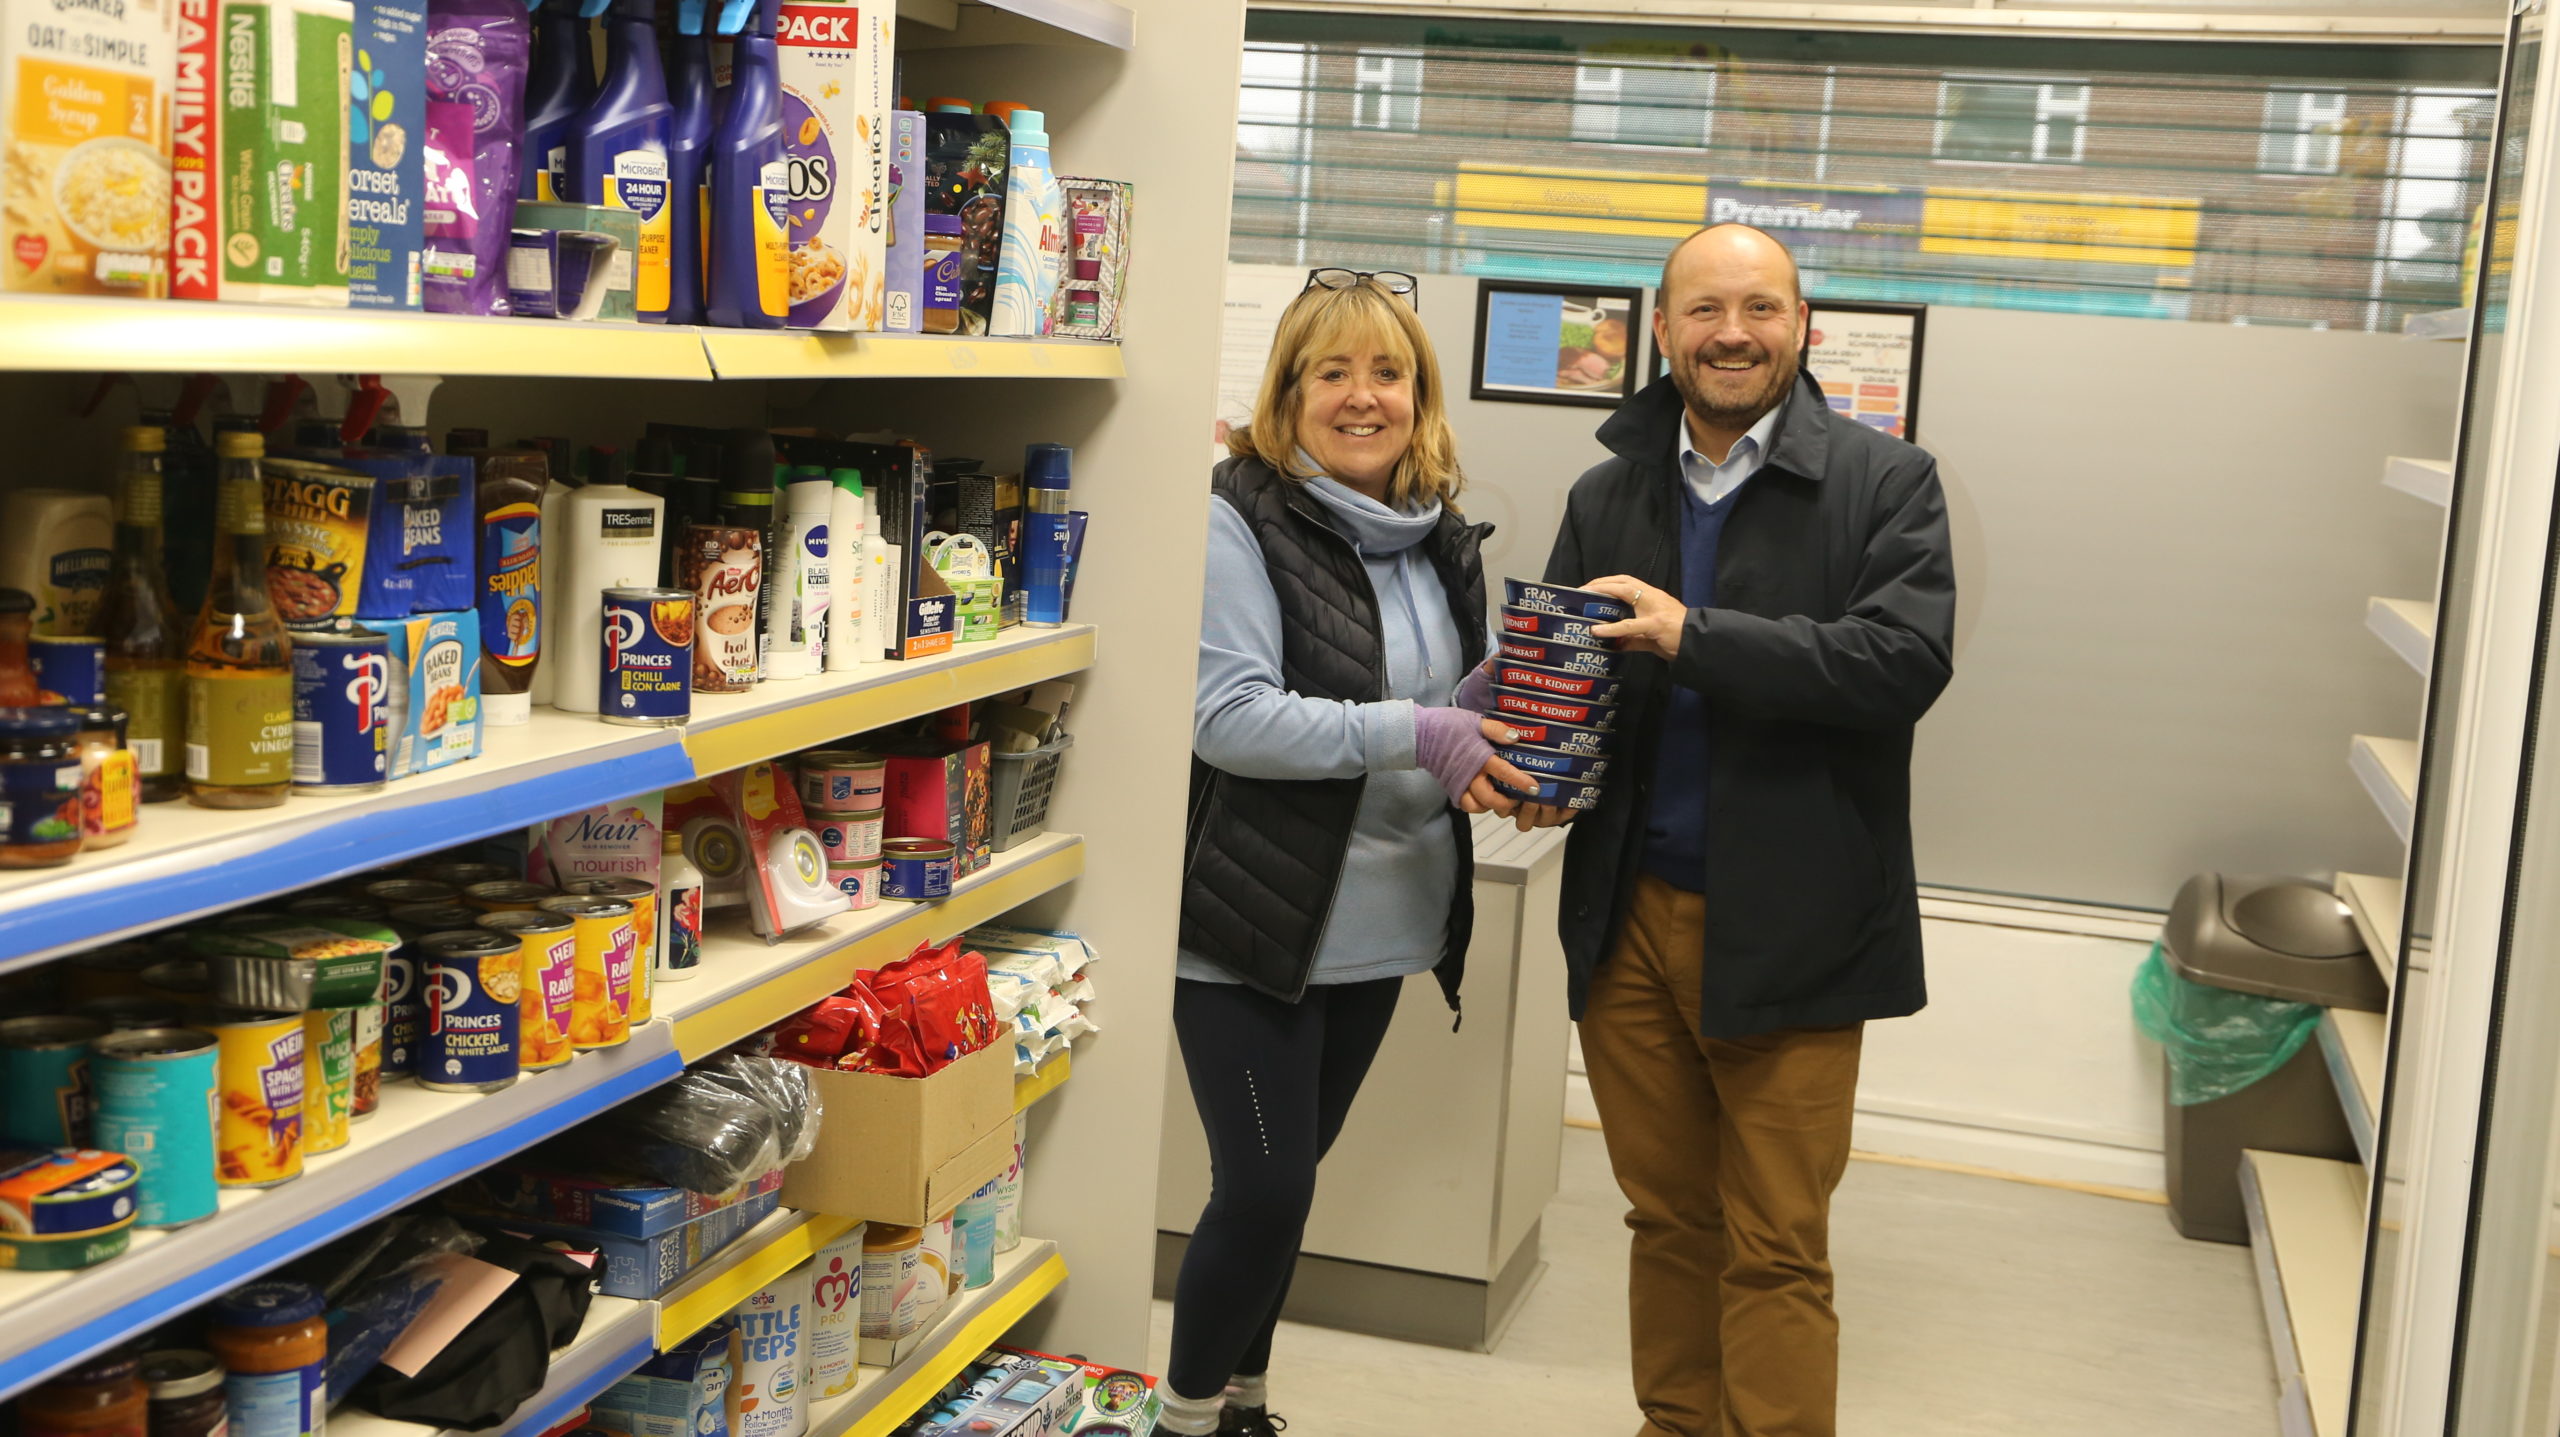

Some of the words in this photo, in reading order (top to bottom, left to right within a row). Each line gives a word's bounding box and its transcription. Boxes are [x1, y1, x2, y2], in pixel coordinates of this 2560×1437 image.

[777, 15, 850, 42] PACK
[28, 23, 66, 50] OAT
[83, 34, 147, 66] SIMPLE
[43, 75, 105, 105] Golden
[48, 100, 98, 134] Syrup
[350, 168, 399, 194] orset
[870, 116, 882, 234] Cheerios
[626, 183, 638, 194] 24
[639, 184, 662, 195] HOUR
[350, 199, 405, 225] ereals
[1712, 198, 1861, 230] Premier
[175, 170, 207, 287] PACK
[640, 245, 658, 254] EANER
[403, 504, 440, 528] BAKED
[272, 521, 331, 543] LASSIC
[403, 526, 442, 555] BEANS
[707, 564, 760, 600] Aero
[809, 577, 829, 585] WHIT
[1524, 587, 1557, 603] FRAY
[919, 601, 945, 616] Gillette
[1519, 598, 1565, 614] BENTOS
[1564, 623, 1592, 638] FRA
[1552, 632, 1603, 648] BENTOS
[621, 653, 672, 666] PRINCES
[1504, 646, 1539, 658] BREAKFAST
[1575, 652, 1608, 665] FRAY
[426, 649, 458, 674] BAKED
[1564, 661, 1609, 676] BENTOS
[633, 671, 662, 681] CHILLI
[1508, 671, 1532, 682] STEAK
[1535, 677, 1542, 685] &
[1545, 679, 1582, 692] KIDNEY
[632, 681, 652, 692] CON
[655, 681, 681, 691] CARNE
[1503, 699, 1528, 709] STEAK
[1541, 705, 1578, 718] KIDNEY
[250, 741, 292, 754] VINEGA
[1572, 733, 1601, 746] FRAY
[1516, 755, 1523, 763] &
[1525, 757, 1555, 769] GRAVY
[565, 813, 648, 843] Nair
[573, 857, 647, 875] nourish
[445, 1014, 501, 1029] PRINCES
[445, 1033, 500, 1047] CHICKEN
[445, 1047, 454, 1056] IN
[457, 1046, 485, 1057] WHITE
[486, 1044, 510, 1055] SAUCE
[595, 1193, 641, 1212] Ravensburger
[646, 1192, 684, 1212] Ravensburger
[659, 1238, 668, 1286] 1000
[667, 1233, 675, 1280] PIECE
[820, 1311, 846, 1327] PRO
[742, 1331, 797, 1362] TEPS
[1065, 1384, 1074, 1399] SIX
[1054, 1389, 1083, 1419] CRACKERS
[762, 1406, 792, 1421] Months
